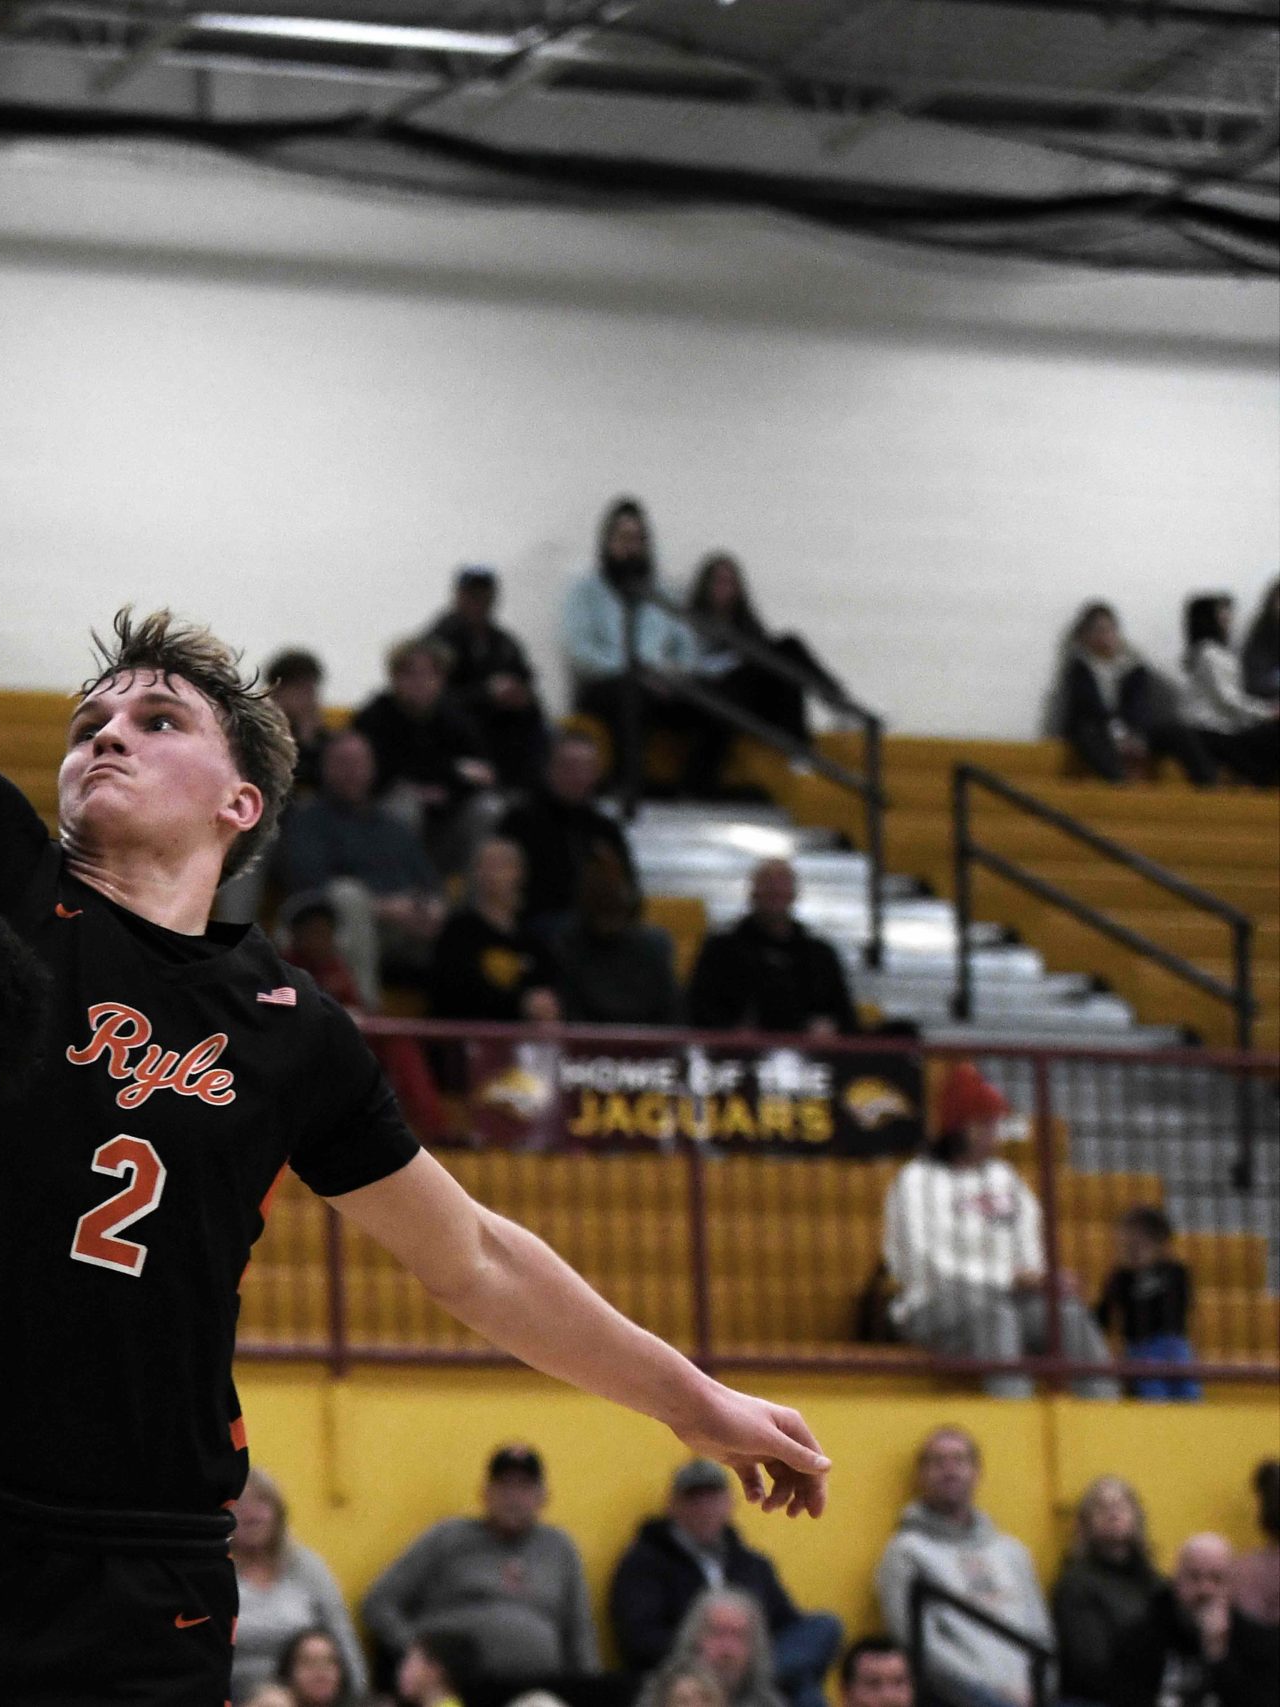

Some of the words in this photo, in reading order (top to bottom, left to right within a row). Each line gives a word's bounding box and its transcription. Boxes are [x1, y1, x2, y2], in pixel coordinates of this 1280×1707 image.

[66, 1002, 236, 1109] Ryle
[559, 1057, 678, 1092] HOME
[757, 1060, 834, 1095] TE
[570, 1090, 834, 1142] JAGUARS
[70, 1134, 167, 1277] 2
